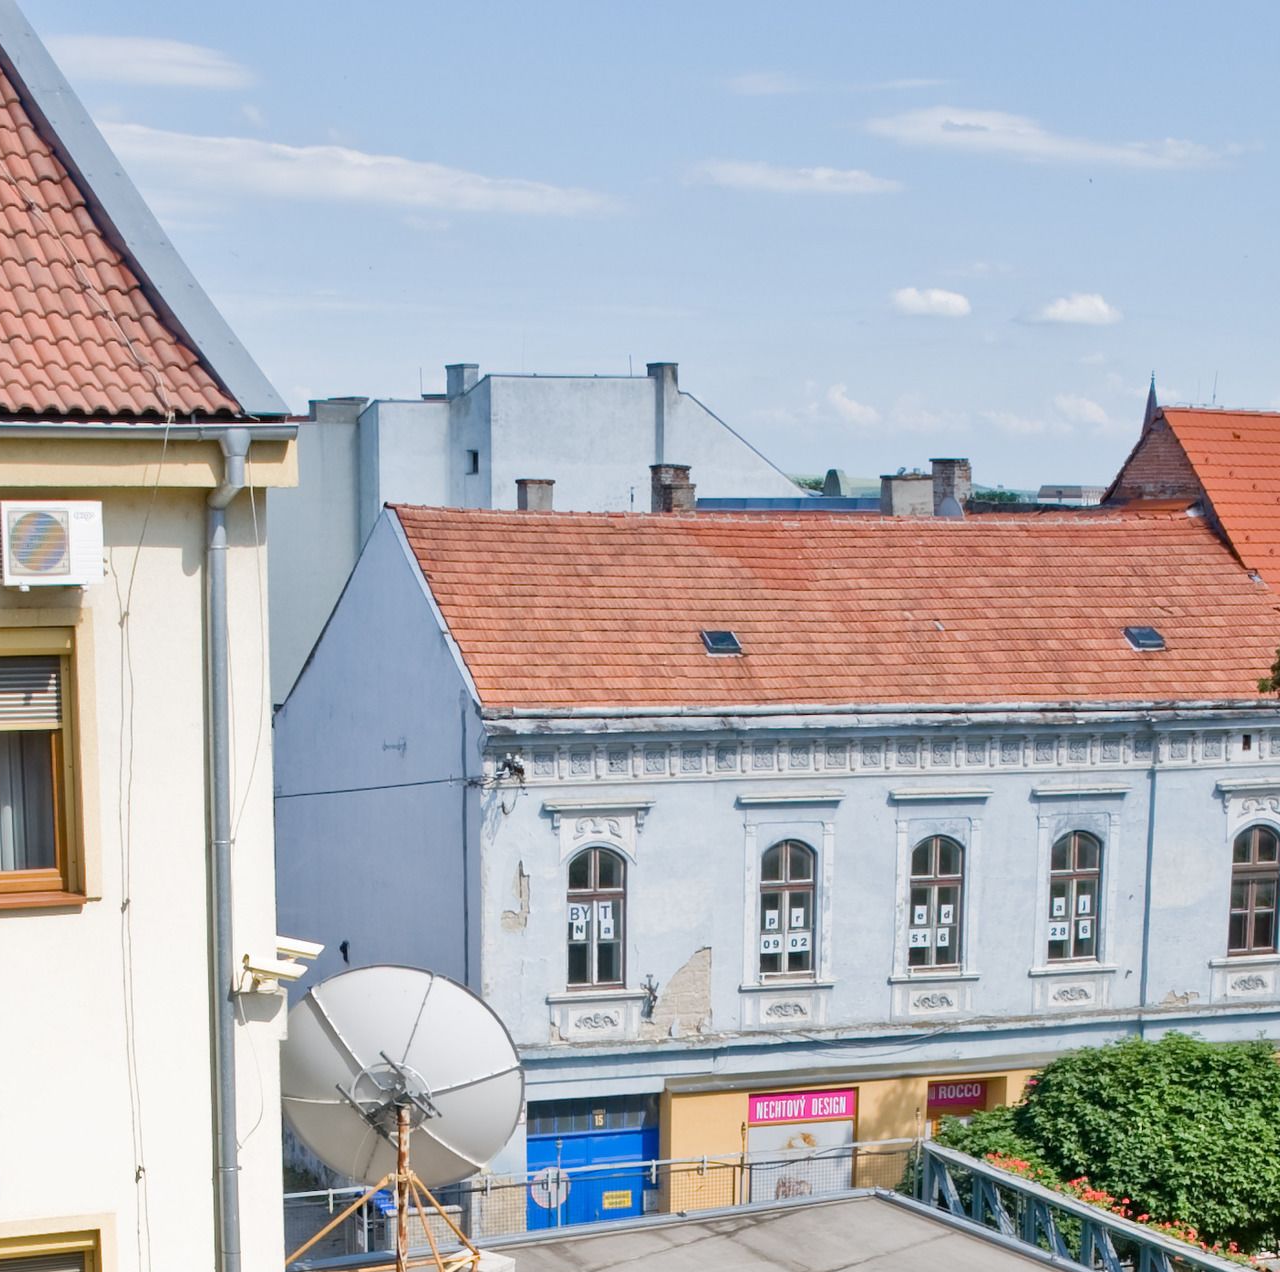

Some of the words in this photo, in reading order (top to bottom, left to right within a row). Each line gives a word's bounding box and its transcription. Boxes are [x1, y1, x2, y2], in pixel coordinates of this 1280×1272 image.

[939, 1083, 981, 1100] ROCCO
[756, 1095, 806, 1119] NECHTOVÝ
[811, 1096, 847, 1116] DESIGN
[594, 1114, 604, 1126] 15
